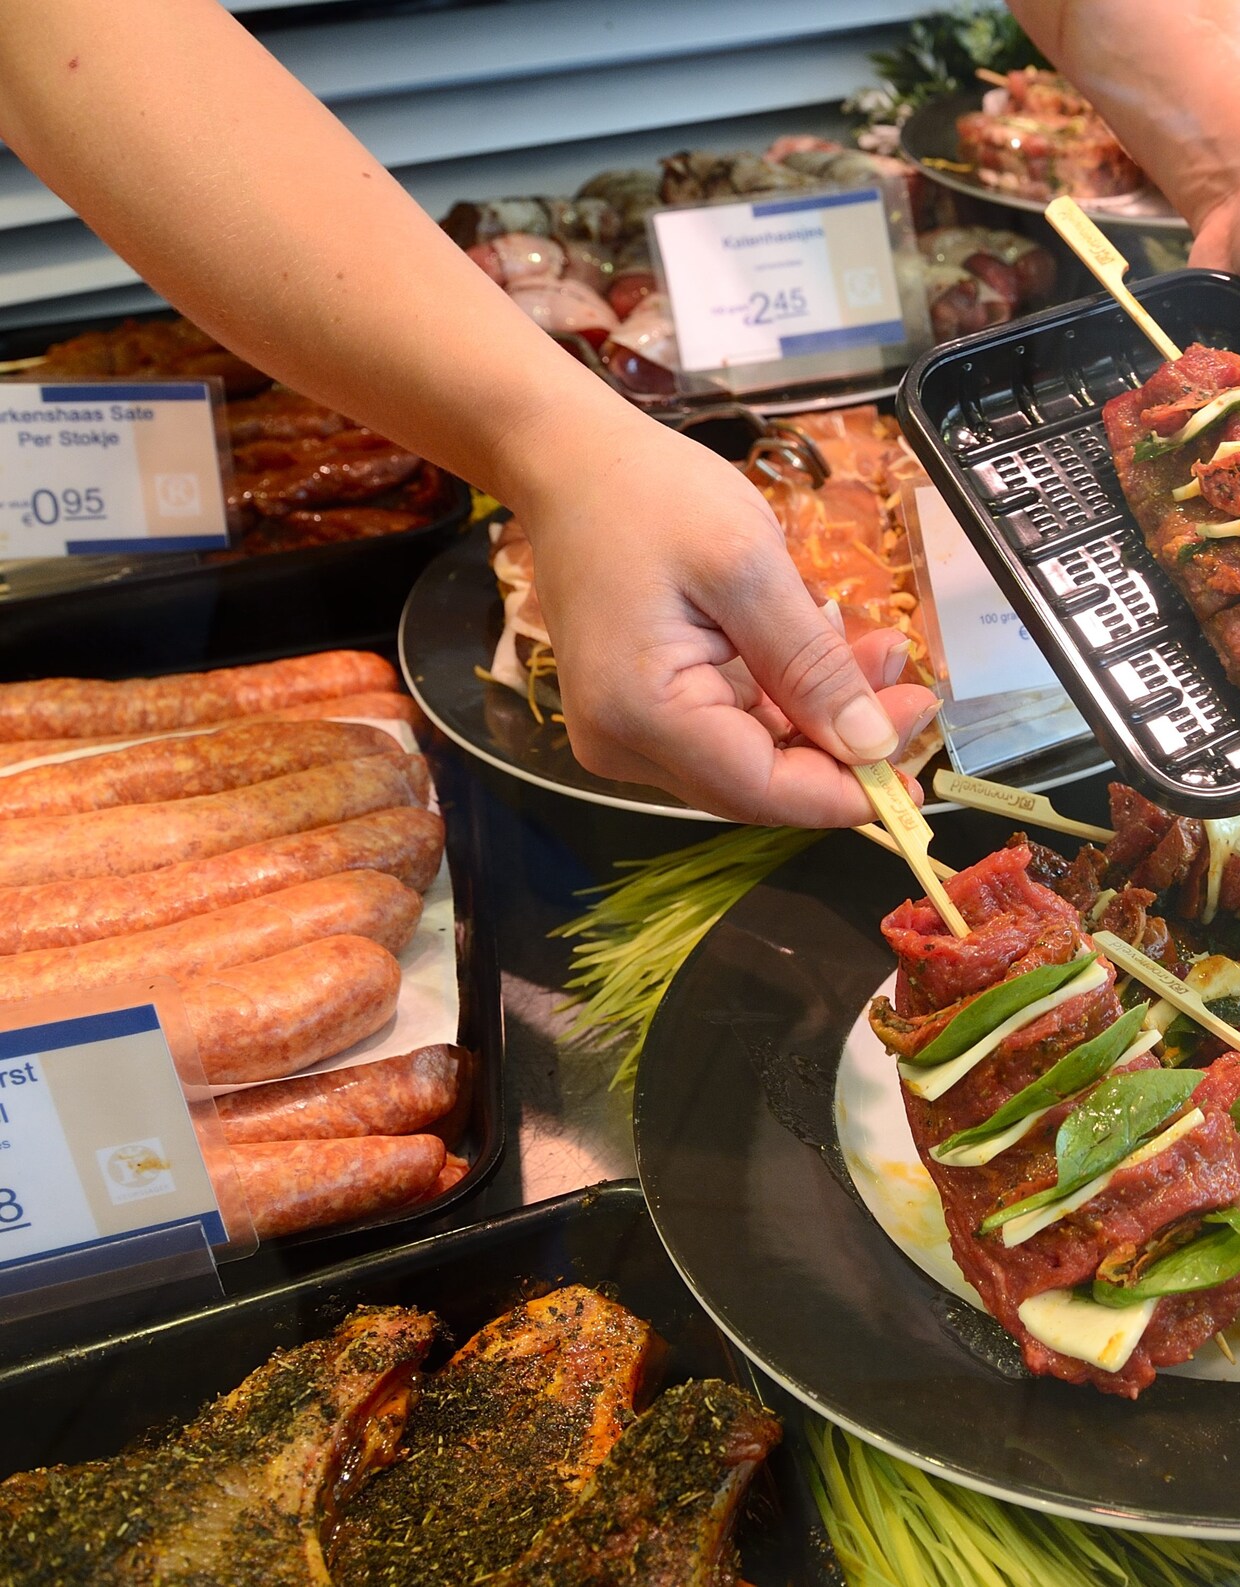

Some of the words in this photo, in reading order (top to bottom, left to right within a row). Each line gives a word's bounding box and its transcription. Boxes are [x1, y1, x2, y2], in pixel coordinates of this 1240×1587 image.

[109, 404, 155, 422] Sate
[18, 430, 52, 447] Per
[58, 429, 120, 449] Stokje
[979, 612, 998, 624] 100
[1000, 612, 1018, 624] gra
